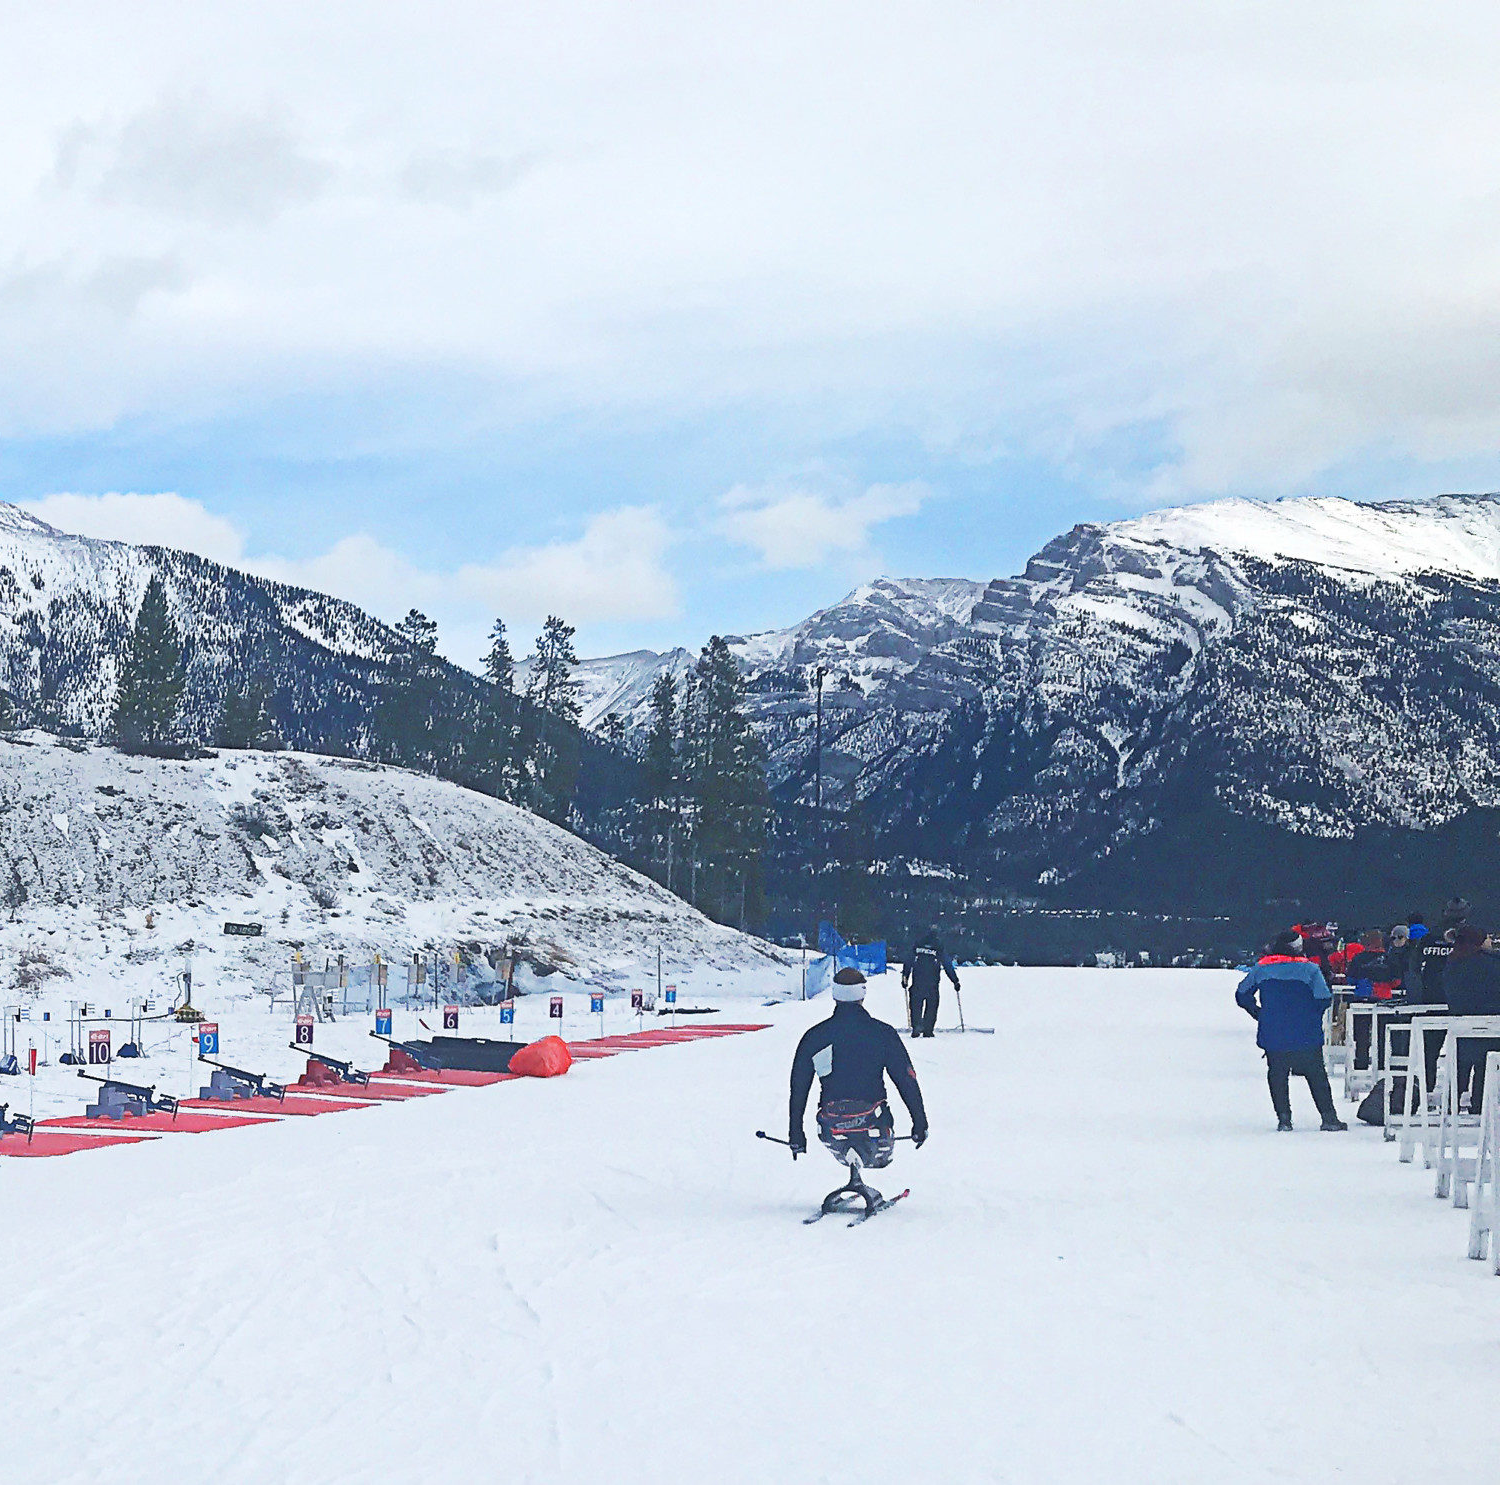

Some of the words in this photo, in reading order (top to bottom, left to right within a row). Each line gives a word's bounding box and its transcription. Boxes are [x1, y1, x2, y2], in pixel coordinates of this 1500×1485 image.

[379, 1018, 388, 1033] 7
[447, 1013, 455, 1027] 6
[300, 1026, 309, 1042] 8
[203, 1034, 214, 1052] 9
[90, 1042, 109, 1063] 10
